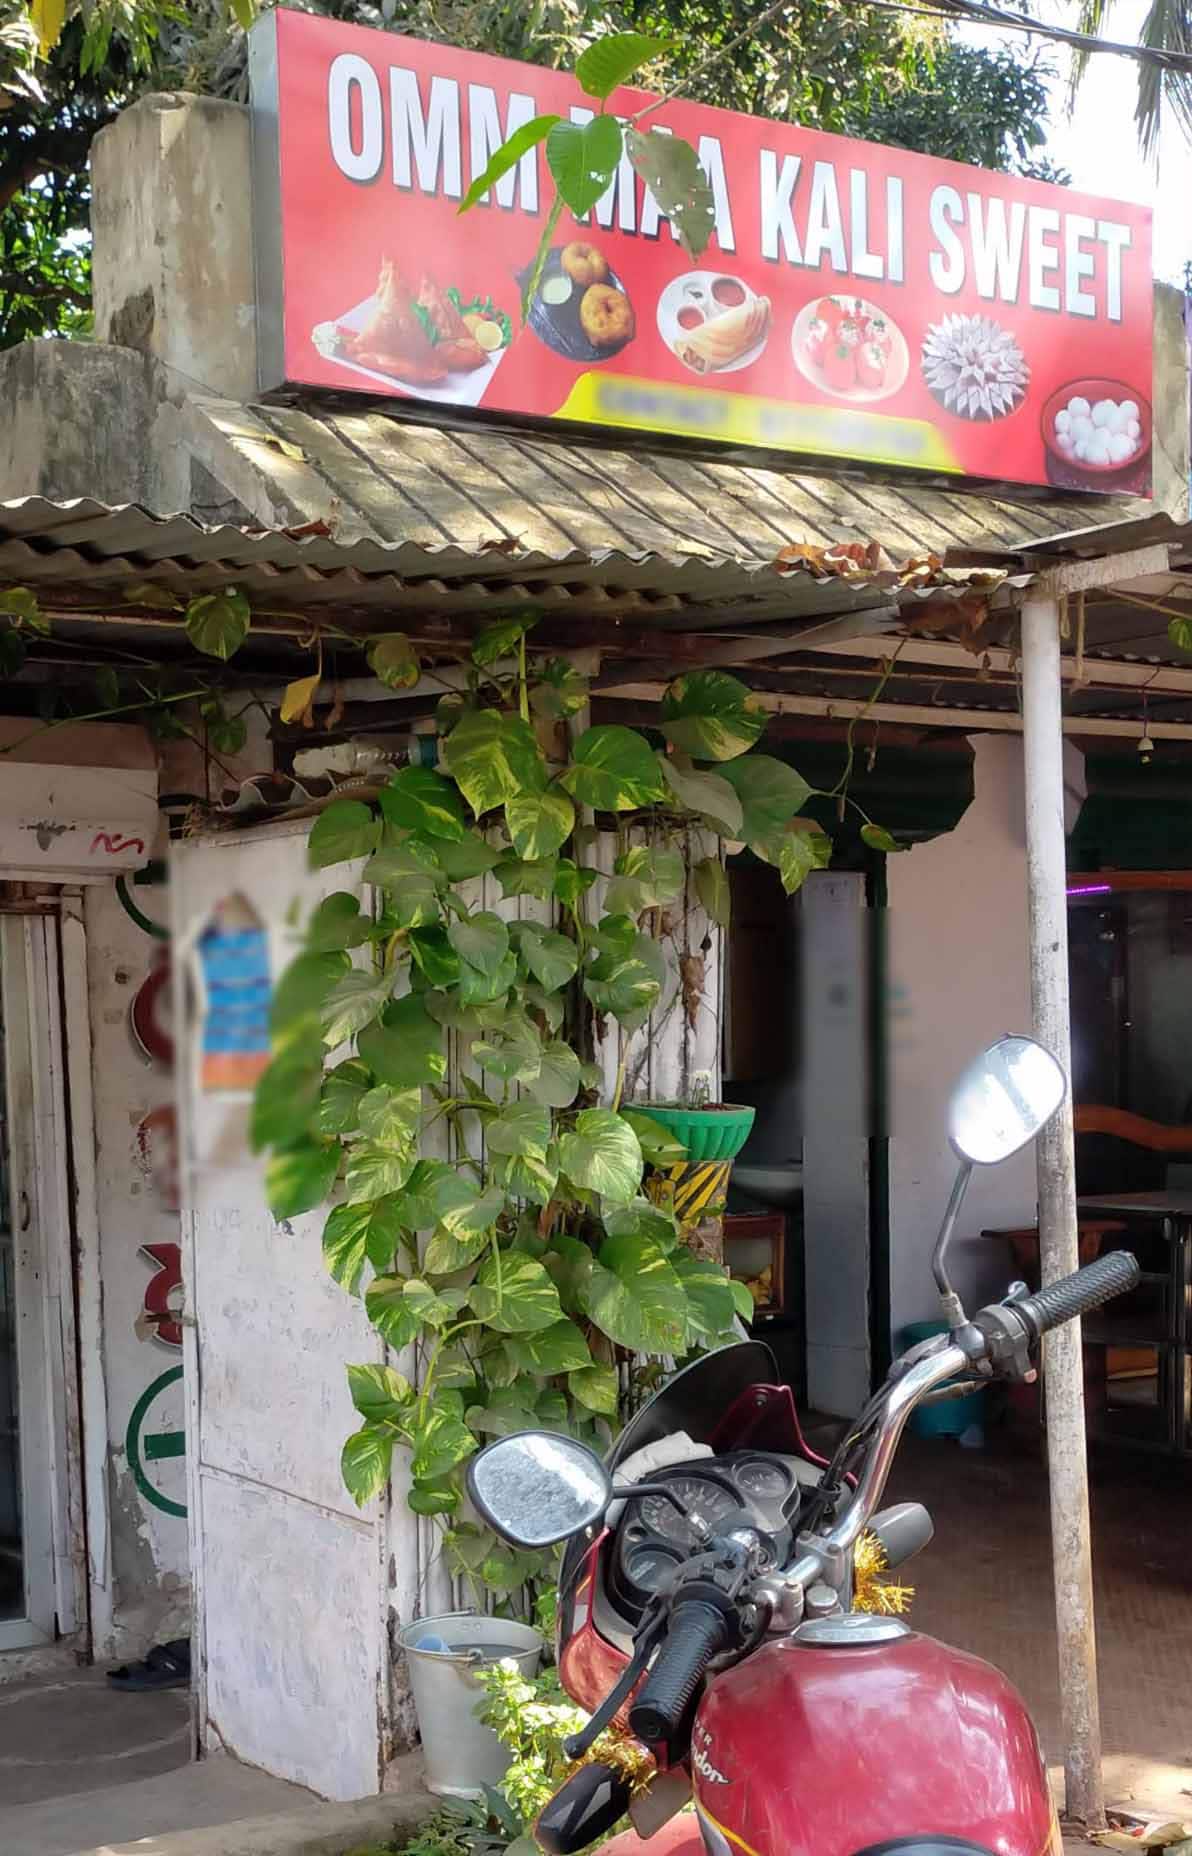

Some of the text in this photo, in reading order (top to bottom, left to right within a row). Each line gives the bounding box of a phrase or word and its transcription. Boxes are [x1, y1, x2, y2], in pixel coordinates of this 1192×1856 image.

[327, 53, 539, 214] OMM
[759, 148, 904, 284] KALI
[928, 185, 1131, 323] SWEET
